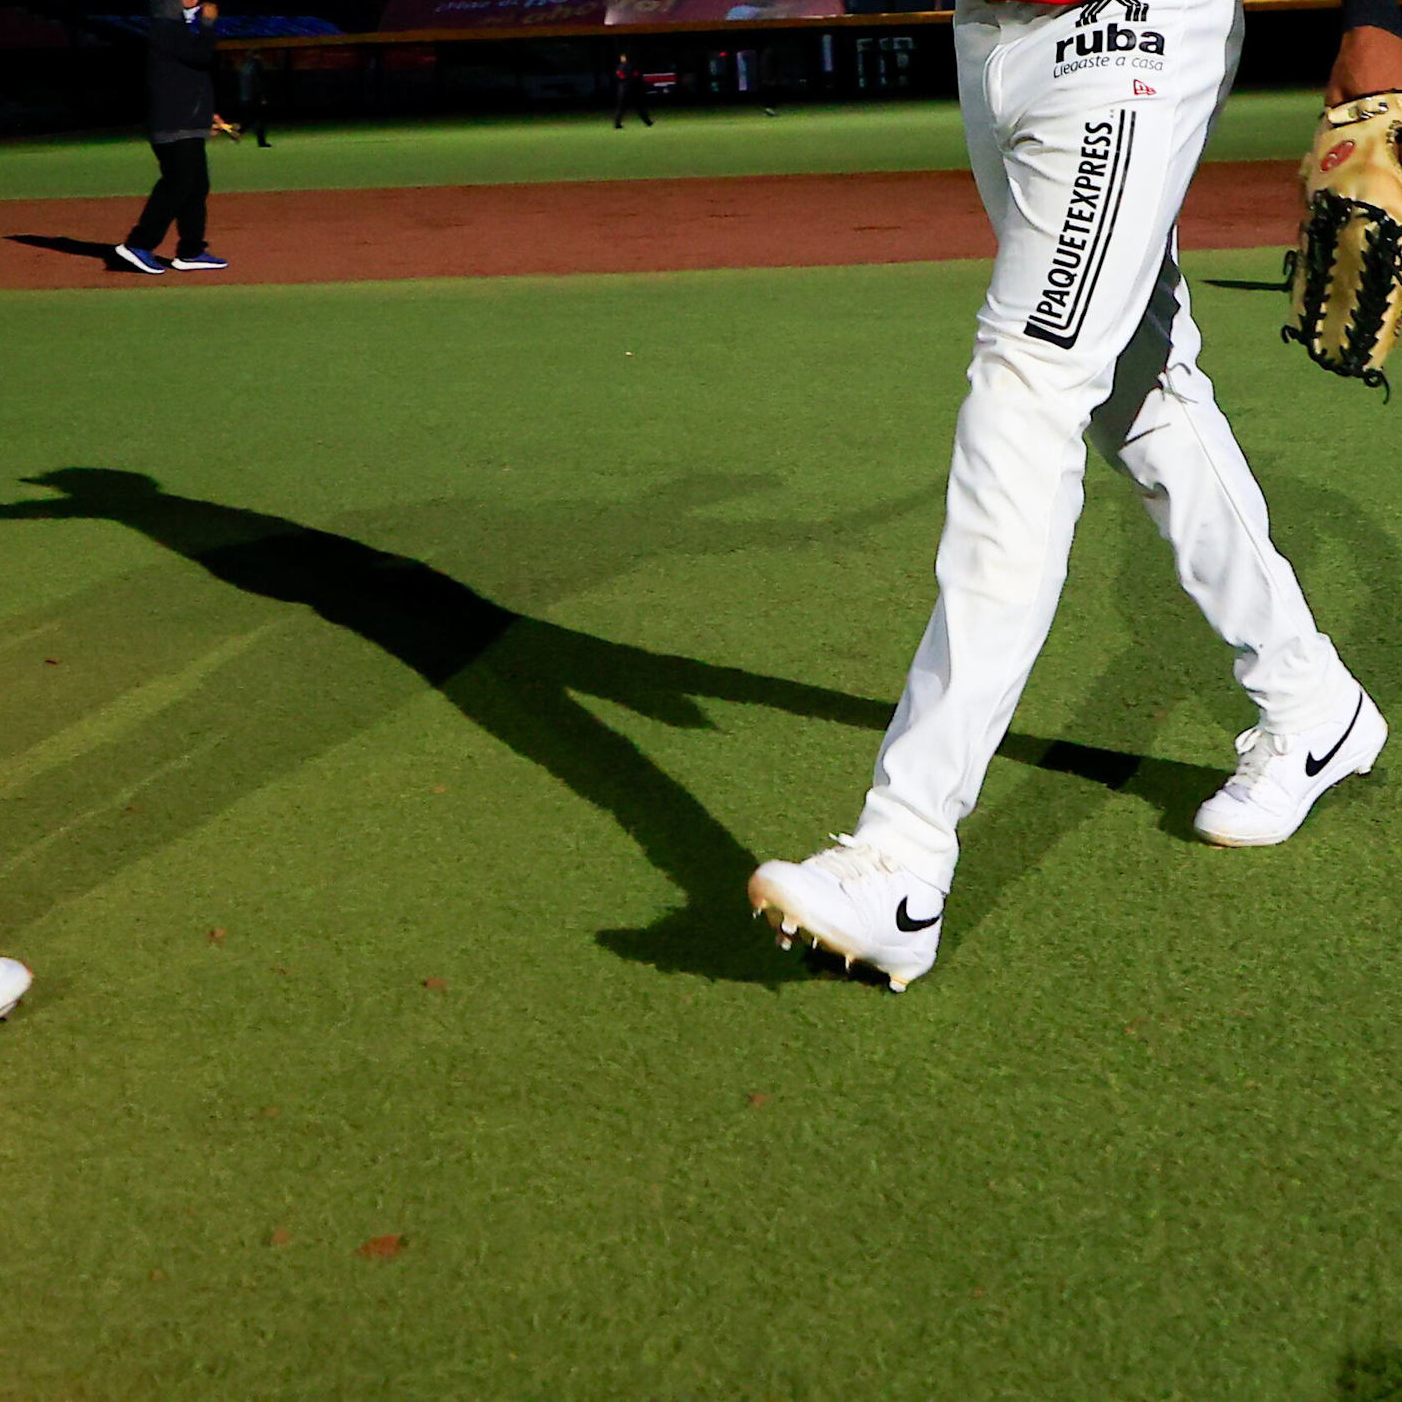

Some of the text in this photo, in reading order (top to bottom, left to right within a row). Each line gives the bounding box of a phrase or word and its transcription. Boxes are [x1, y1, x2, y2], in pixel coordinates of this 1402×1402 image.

[1056, 23, 1165, 63] ruba
[1115, 56, 1126, 67] a
[1131, 57, 1164, 71] casa
[1035, 121, 1113, 319] PAQUETEXPRESS
